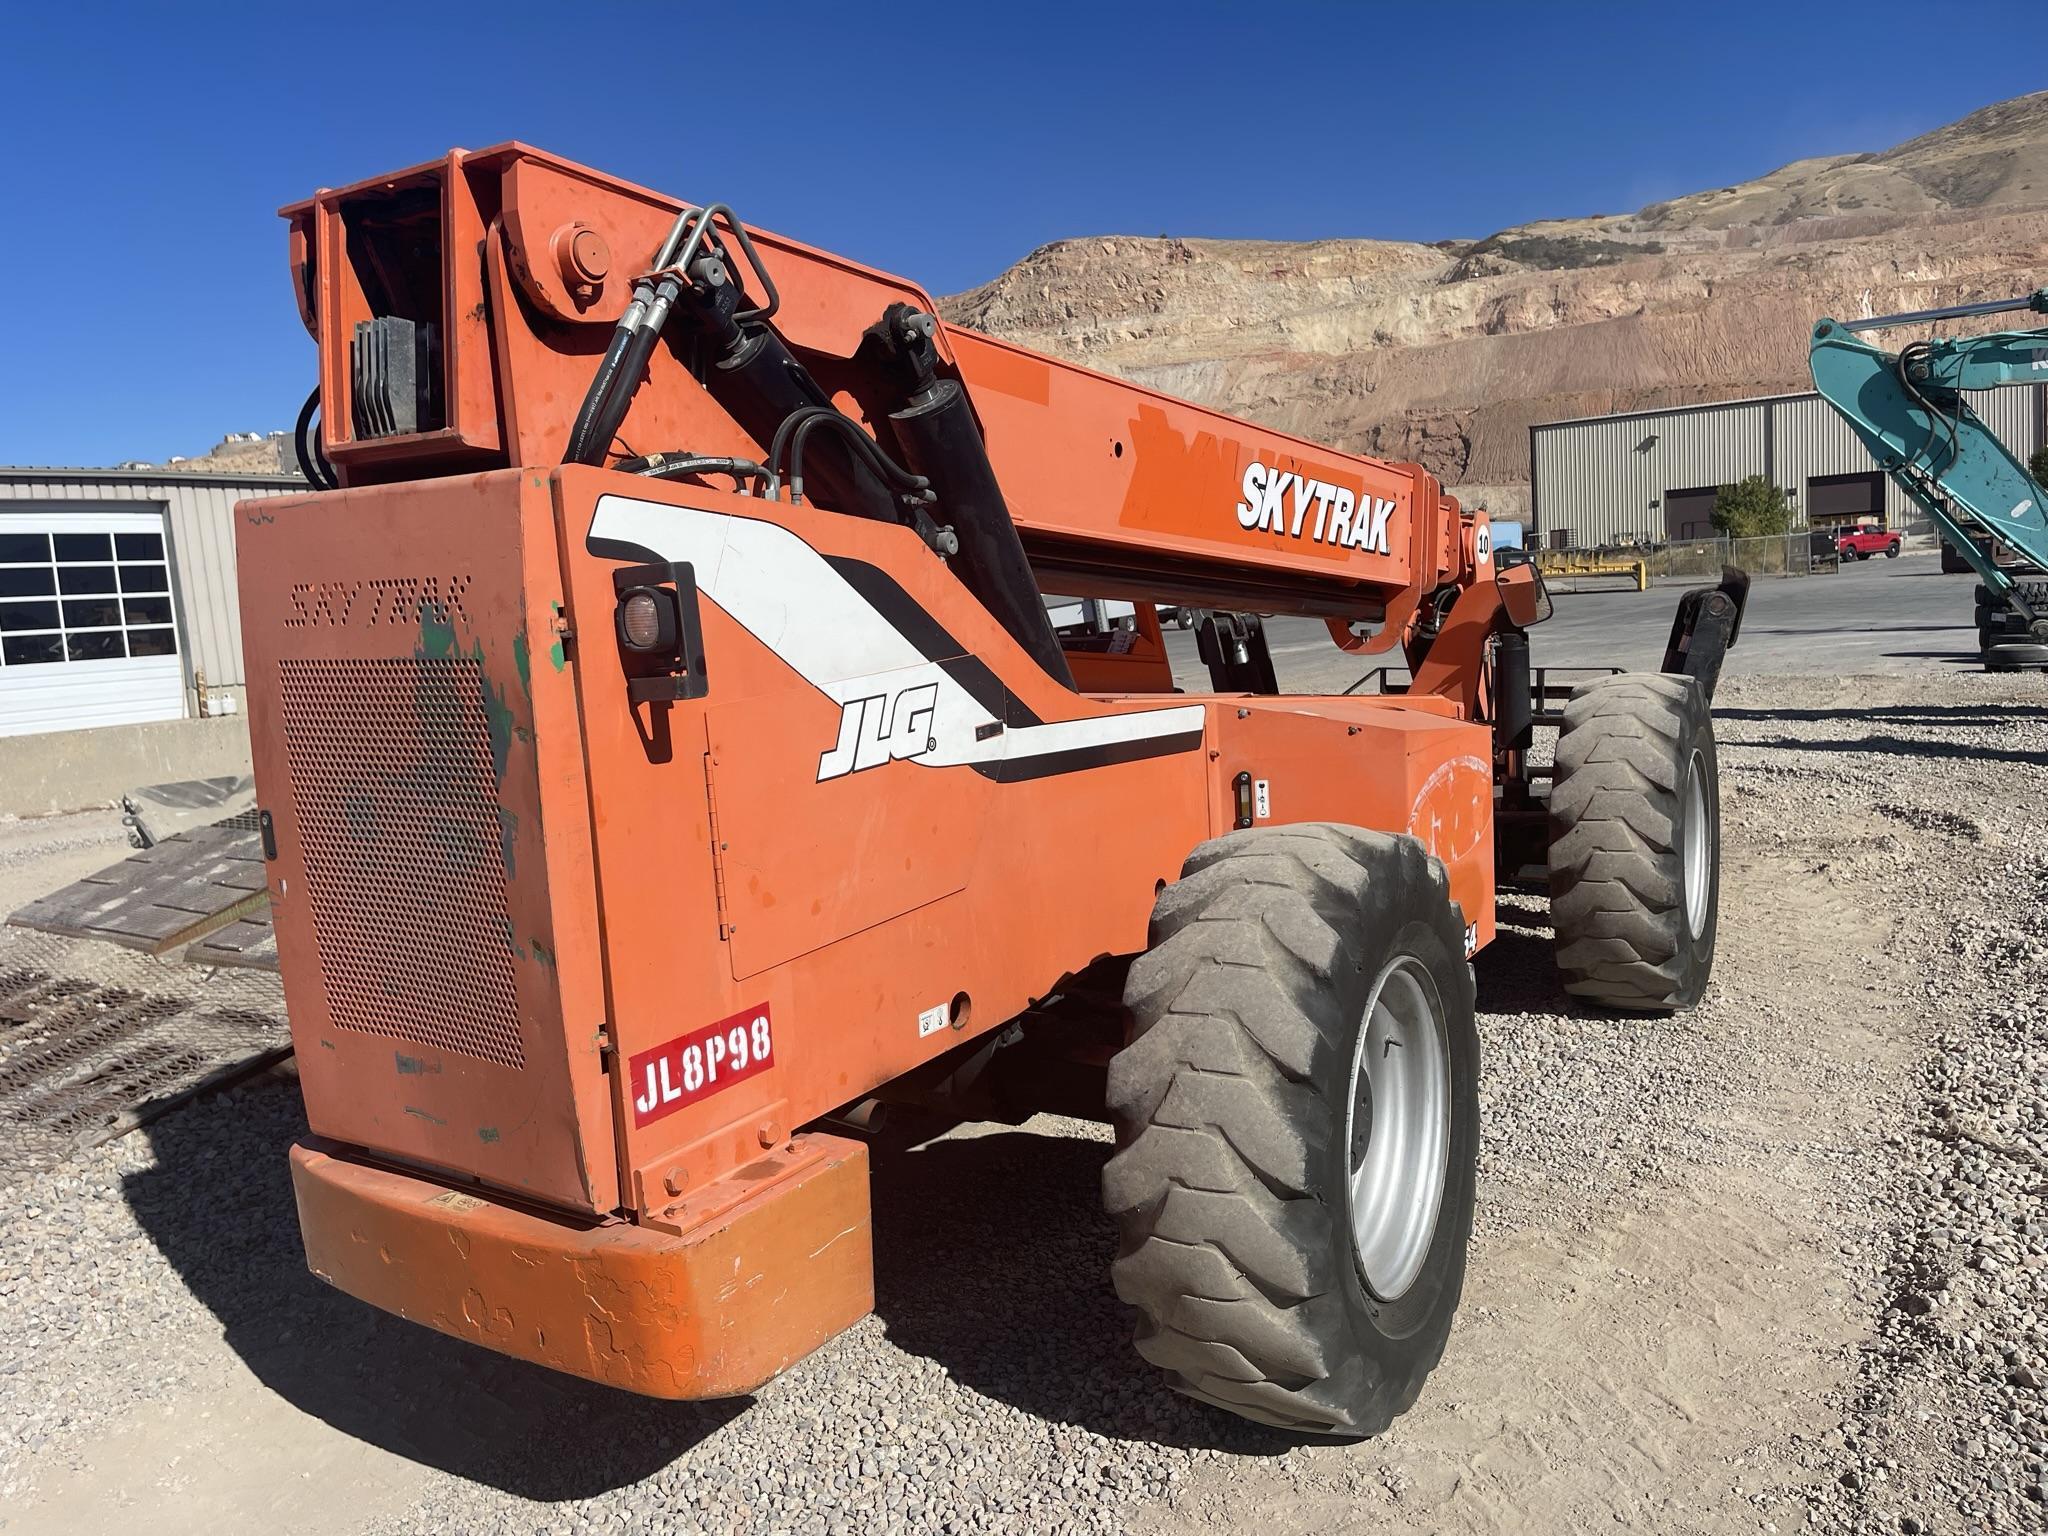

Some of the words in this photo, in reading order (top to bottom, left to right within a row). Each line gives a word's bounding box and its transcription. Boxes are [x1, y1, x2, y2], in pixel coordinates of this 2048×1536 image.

[1237, 461, 1396, 555] SKYTRAK
[1479, 534, 1489, 554] 10
[284, 575, 472, 628] SKYTRAK
[816, 682, 938, 784] JLG
[636, 1016, 771, 1112] JL8P98
